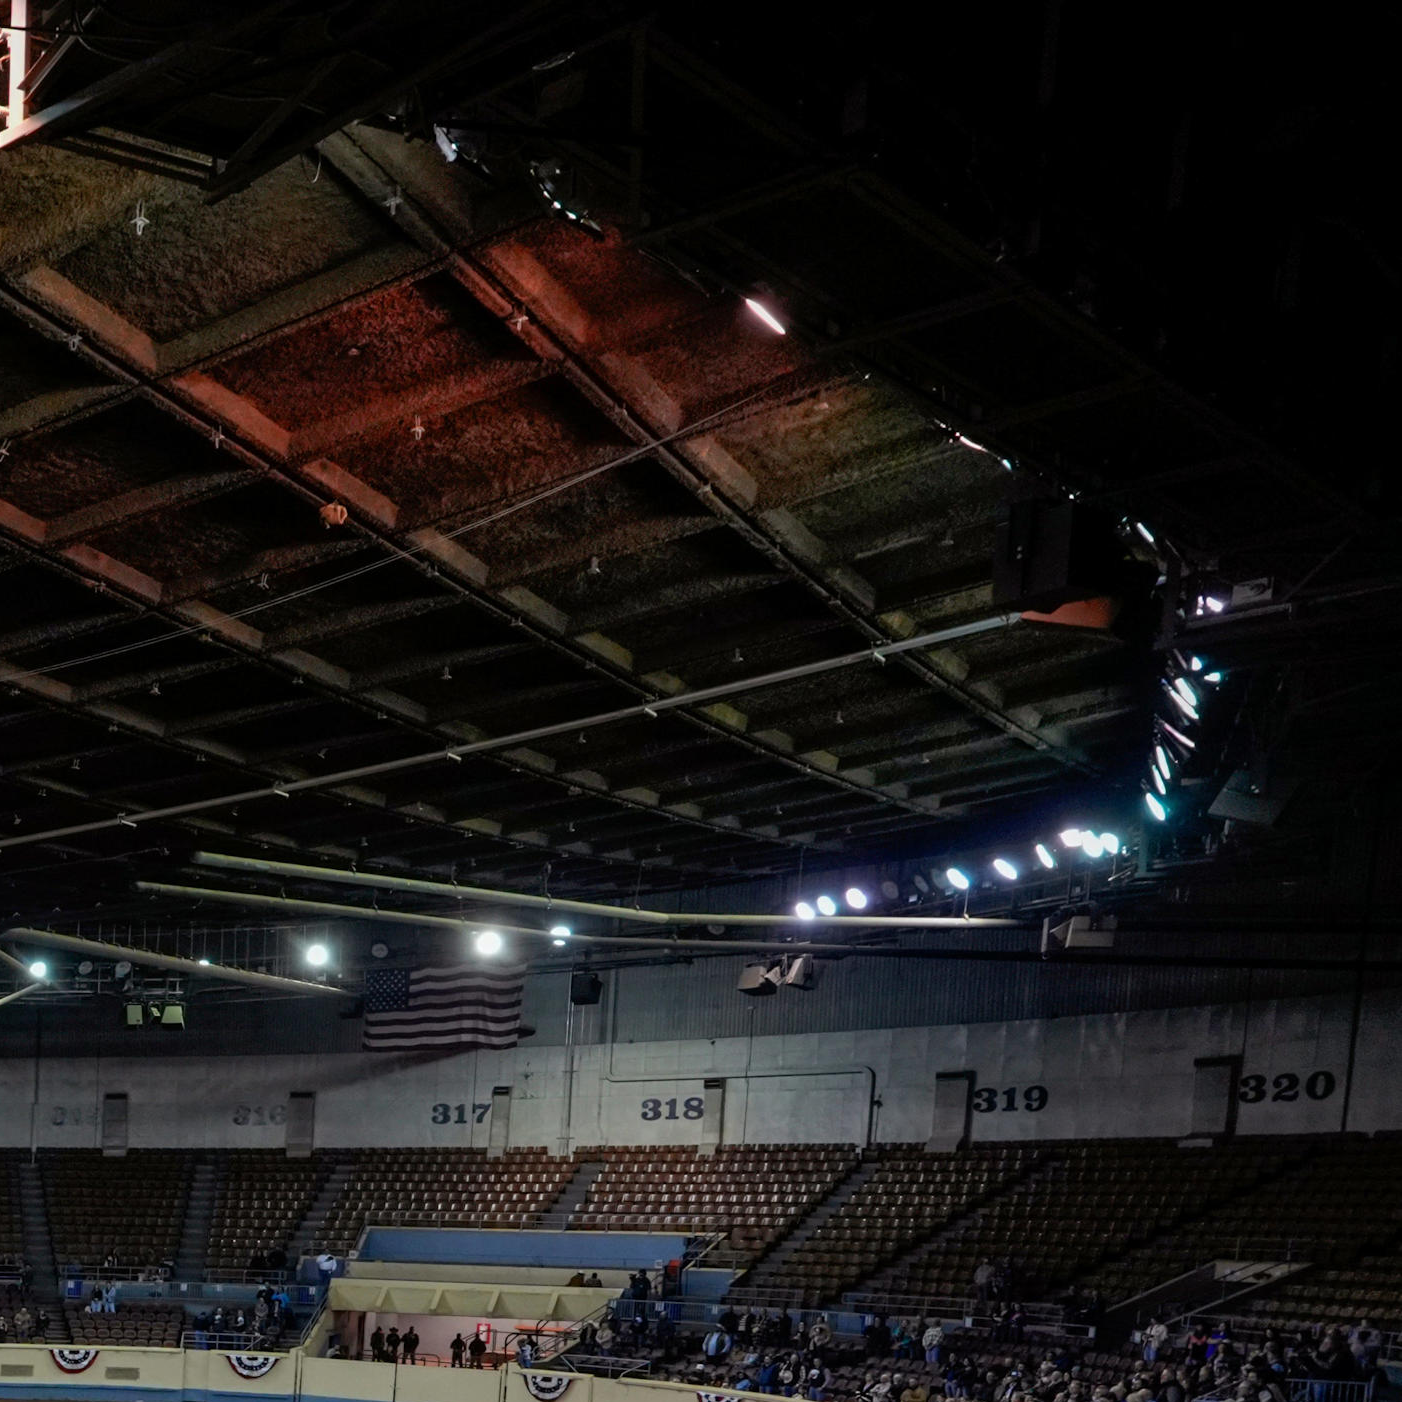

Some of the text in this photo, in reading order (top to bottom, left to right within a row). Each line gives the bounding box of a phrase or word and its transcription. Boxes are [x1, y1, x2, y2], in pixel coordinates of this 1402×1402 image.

[972, 1085, 1049, 1112] 319
[1238, 1070, 1336, 1103] 320
[431, 1103, 492, 1124] 317
[640, 1097, 705, 1120] 318
